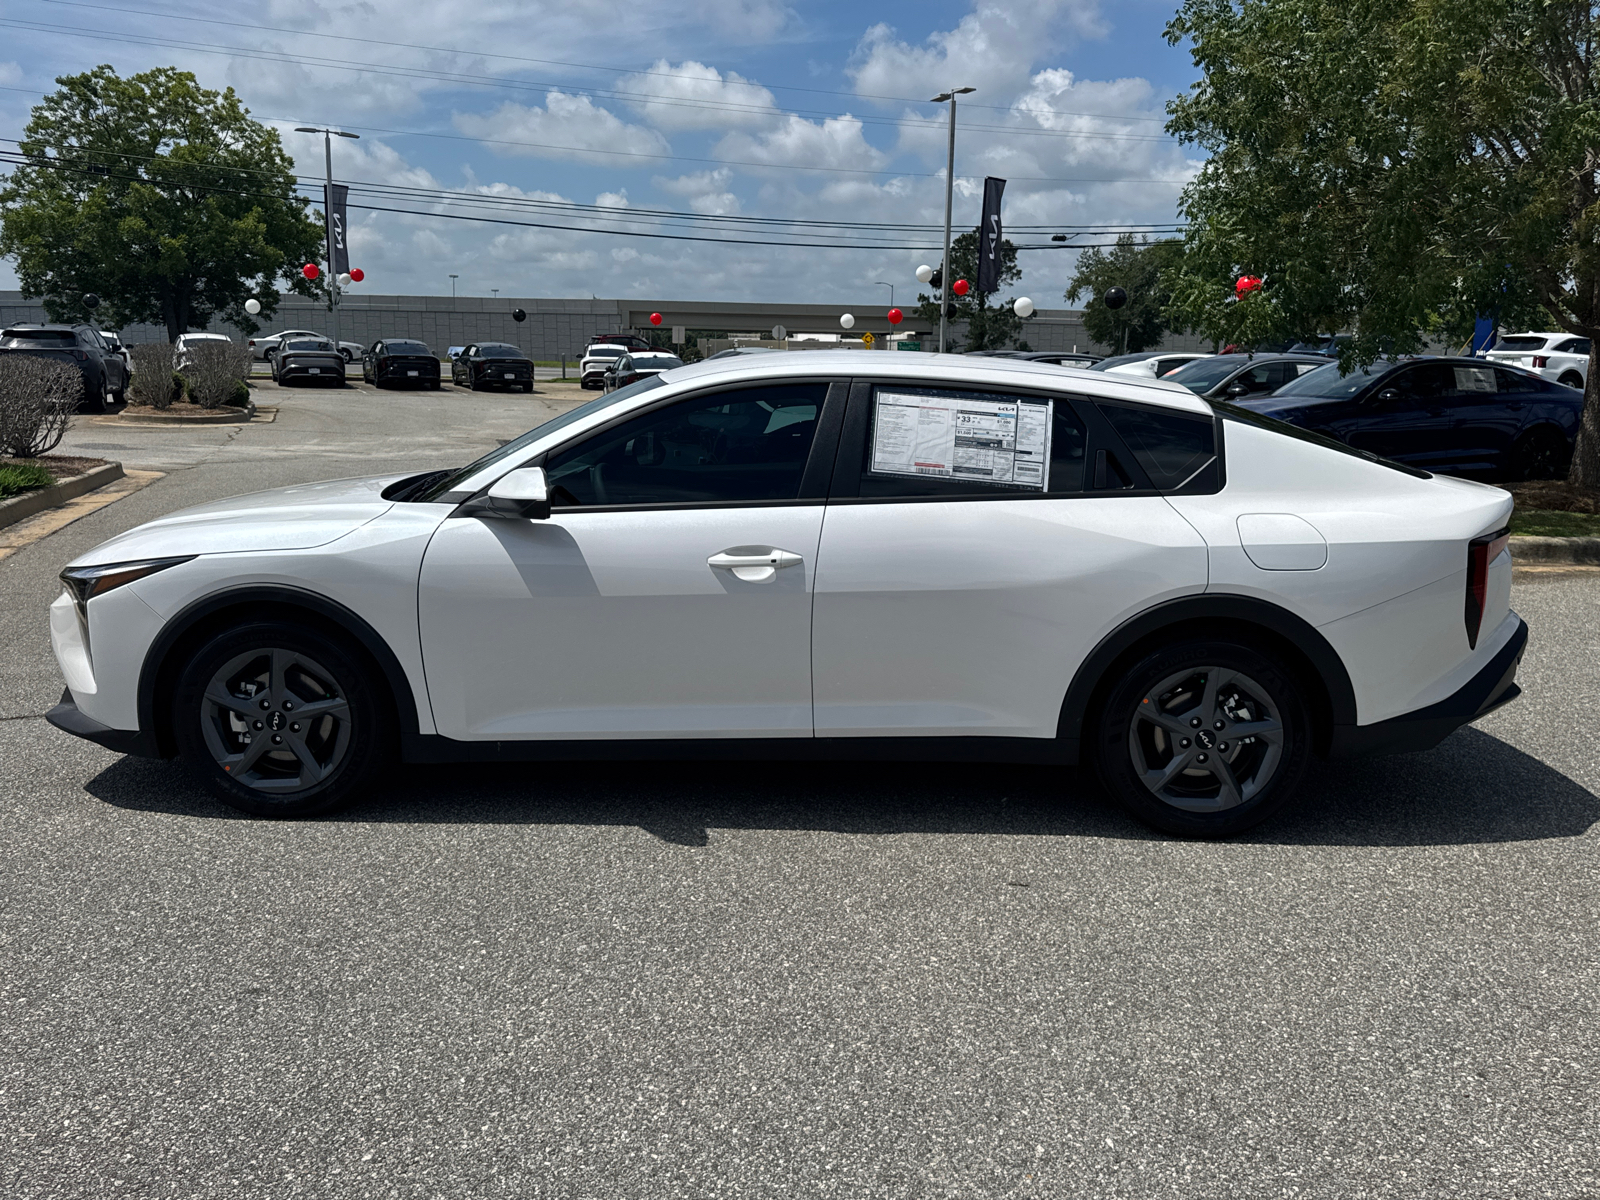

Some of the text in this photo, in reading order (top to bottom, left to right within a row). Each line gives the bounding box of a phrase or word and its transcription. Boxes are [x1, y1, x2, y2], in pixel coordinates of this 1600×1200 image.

[333, 212, 343, 249] KIA
[988, 214, 999, 260] KIA
[961, 415, 971, 423] 33
[1198, 730, 1213, 750] KIA
